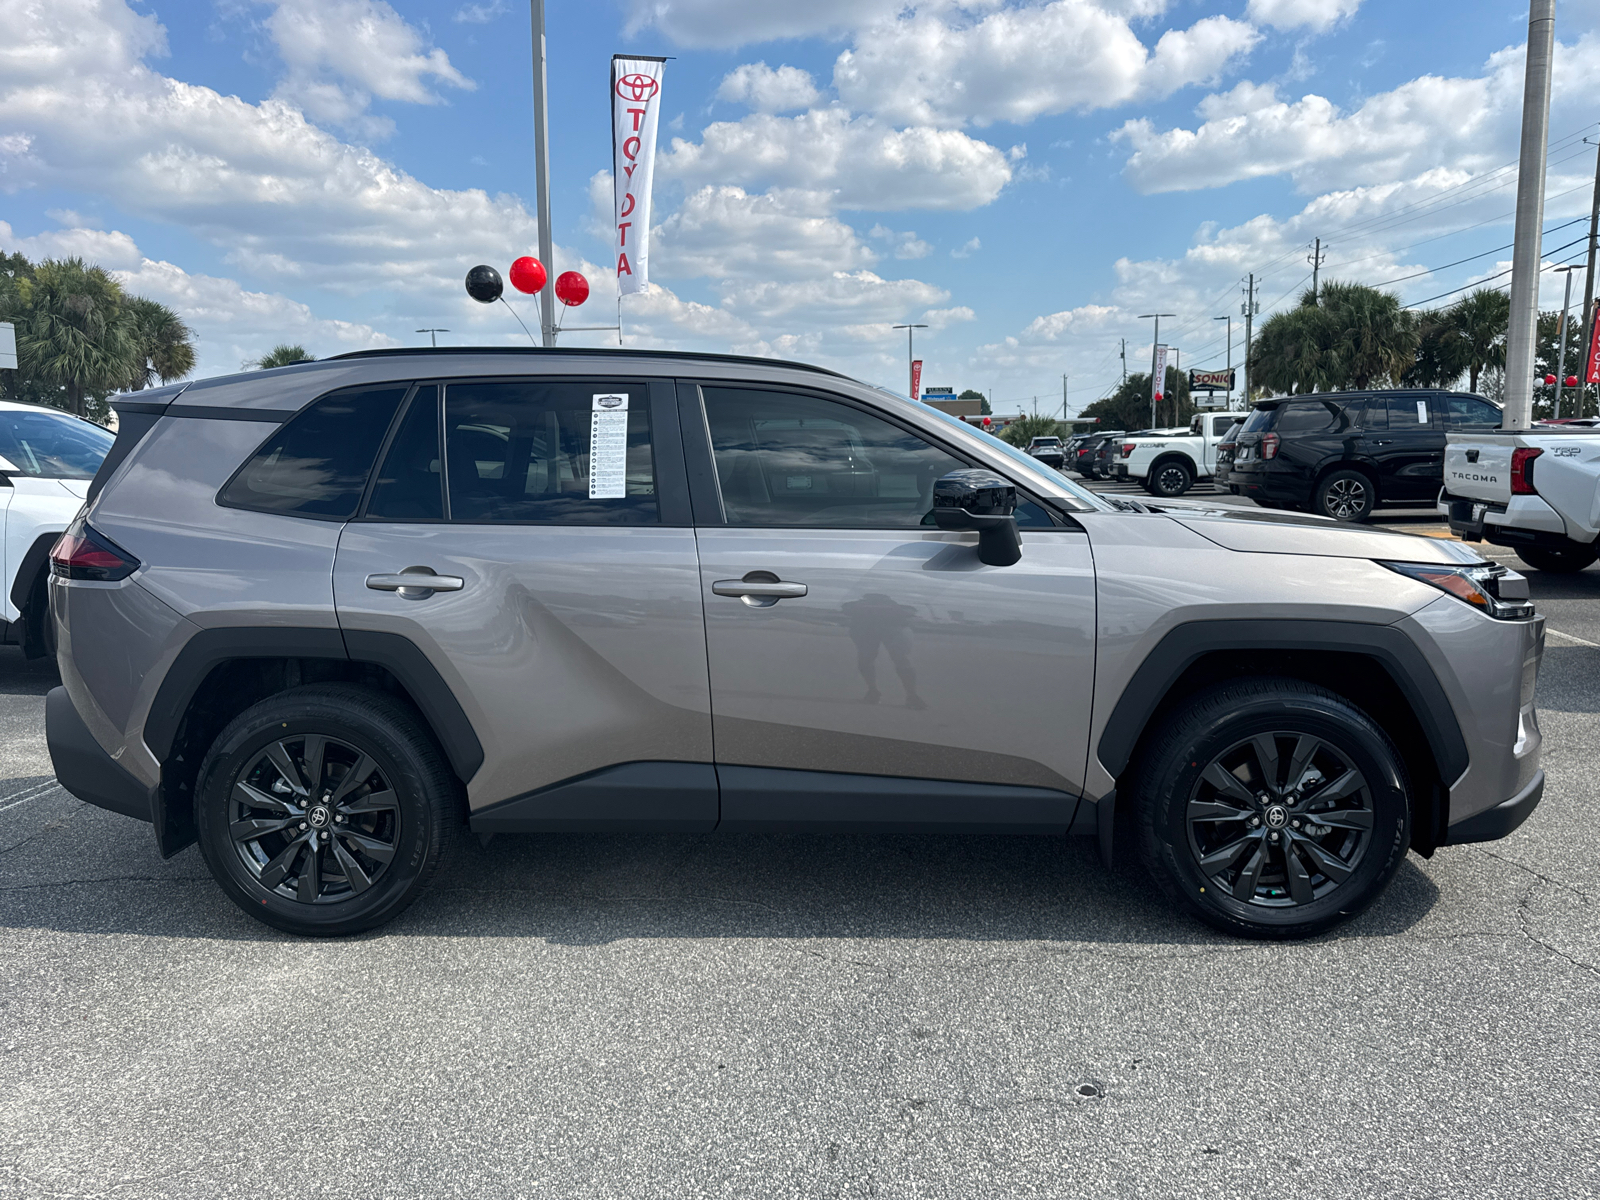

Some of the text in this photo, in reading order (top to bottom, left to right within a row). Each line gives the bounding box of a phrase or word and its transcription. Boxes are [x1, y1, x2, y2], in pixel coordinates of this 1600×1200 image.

[617, 109, 645, 278] TOYOTA
[1195, 374, 1229, 384] SONIC
[1452, 472, 1497, 483] TACOMA
